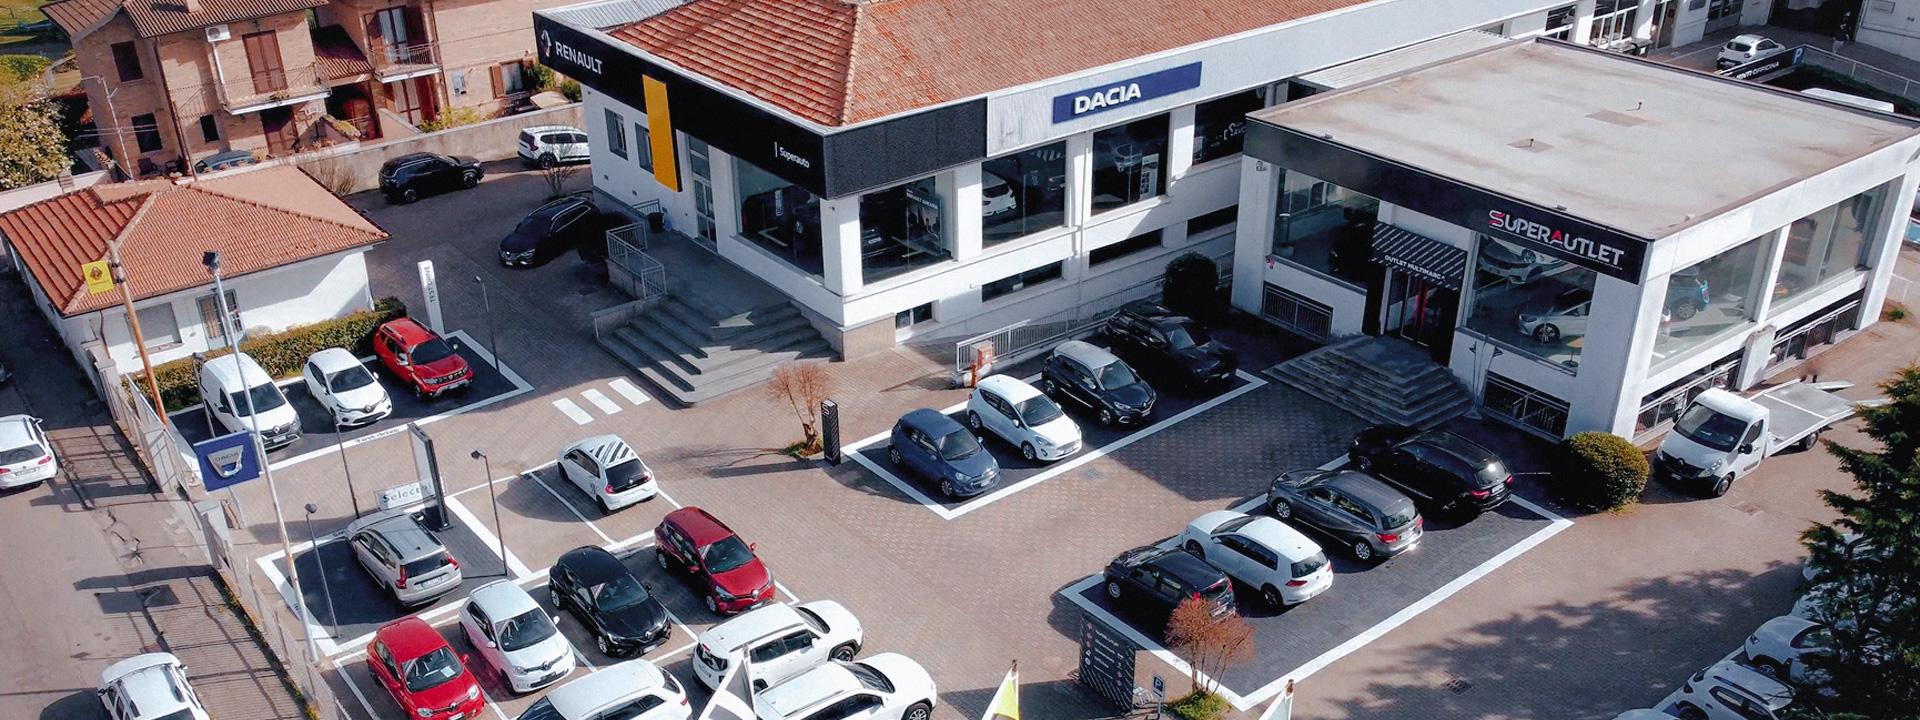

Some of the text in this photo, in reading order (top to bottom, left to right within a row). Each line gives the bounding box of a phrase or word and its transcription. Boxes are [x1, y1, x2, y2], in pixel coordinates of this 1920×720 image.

[555, 41, 602, 74] RENAULT
[1794, 48, 1802, 63] P
[1752, 61, 1780, 75] OFFICINA
[1074, 83, 1142, 114] DACIA
[780, 146, 810, 168] Superauto
[1488, 209, 1624, 266] SUPERAUTLET
[1384, 255, 1407, 267] OUTLET
[428, 287, 436, 303] TEST
[214, 452, 240, 462] DACIA
[1154, 678, 1162, 688] P
